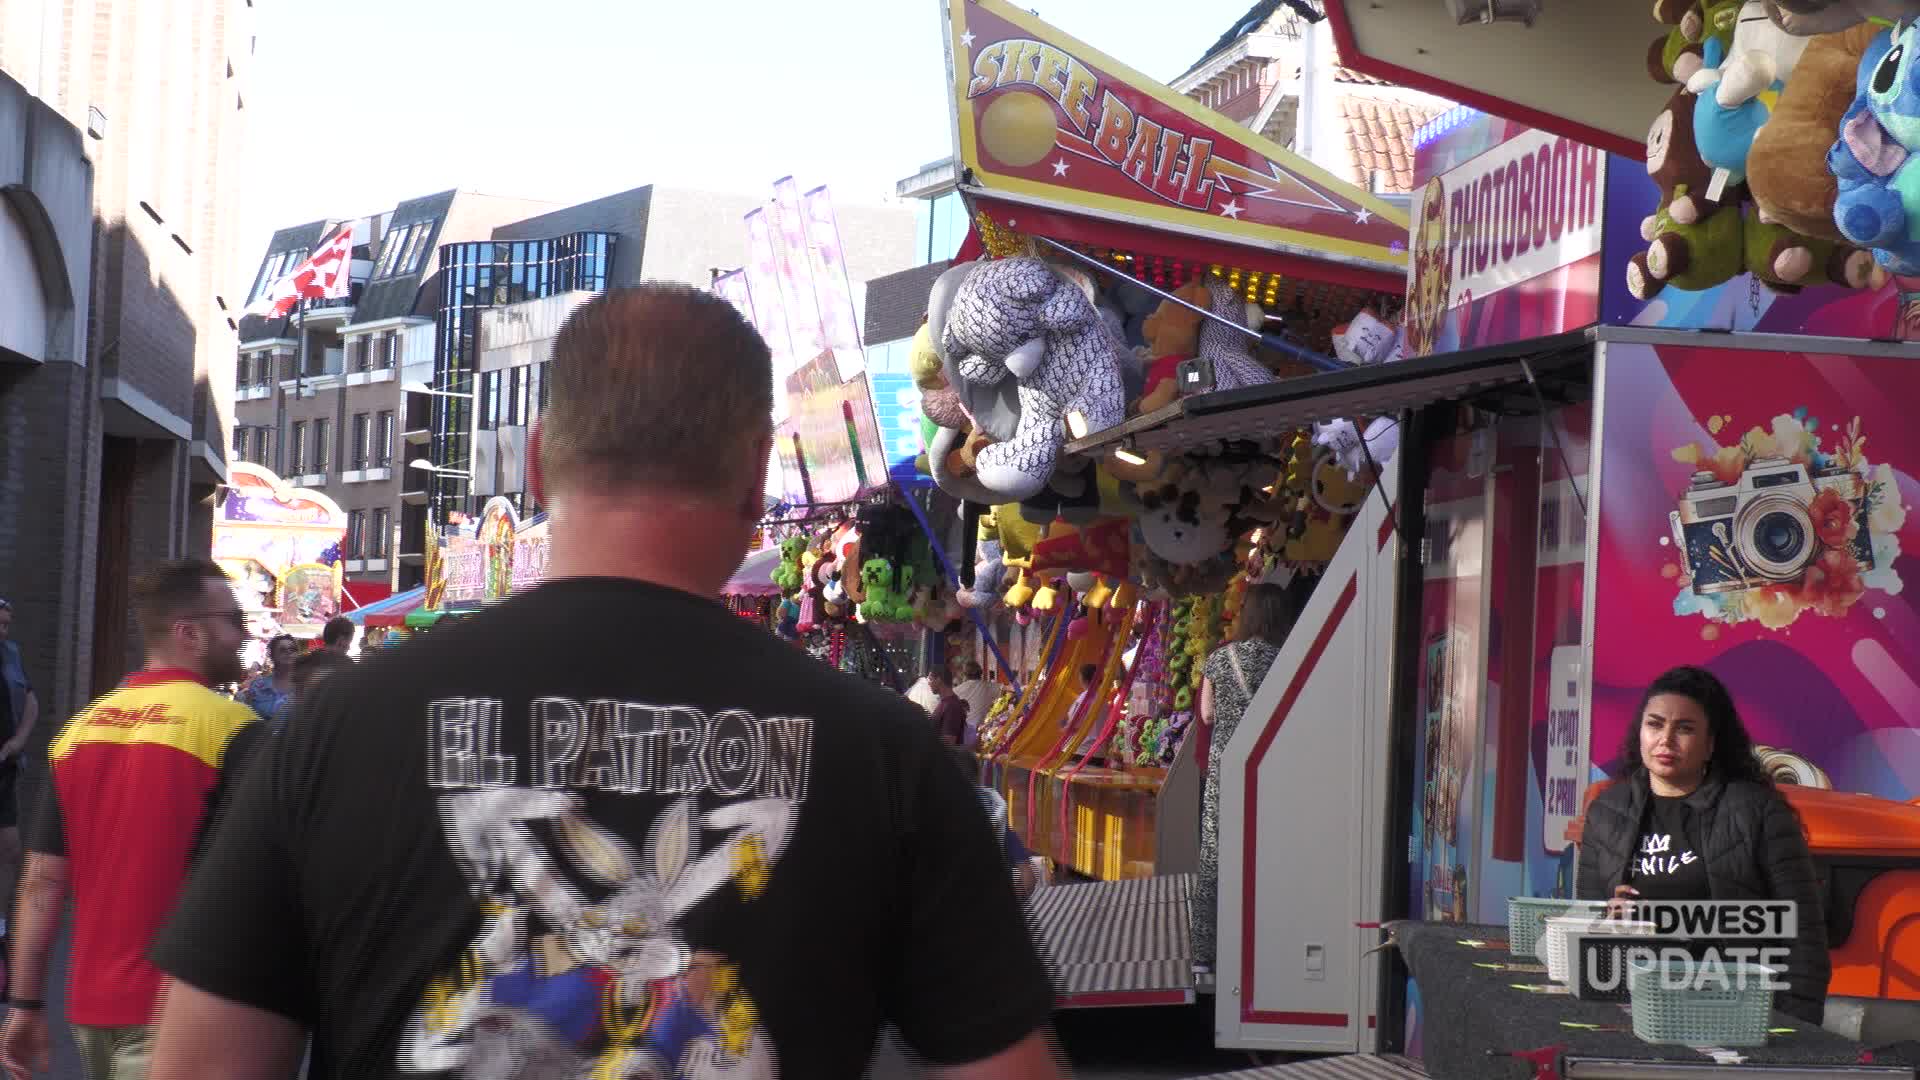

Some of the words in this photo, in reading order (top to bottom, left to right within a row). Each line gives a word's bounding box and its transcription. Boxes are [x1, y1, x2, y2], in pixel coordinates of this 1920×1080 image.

[967, 39, 1098, 136] SKEE
[1093, 89, 1216, 211] BALL
[1446, 137, 1599, 280] PHOTOBOOTH
[427, 697, 517, 788] EL
[530, 697, 814, 803] PATRON
